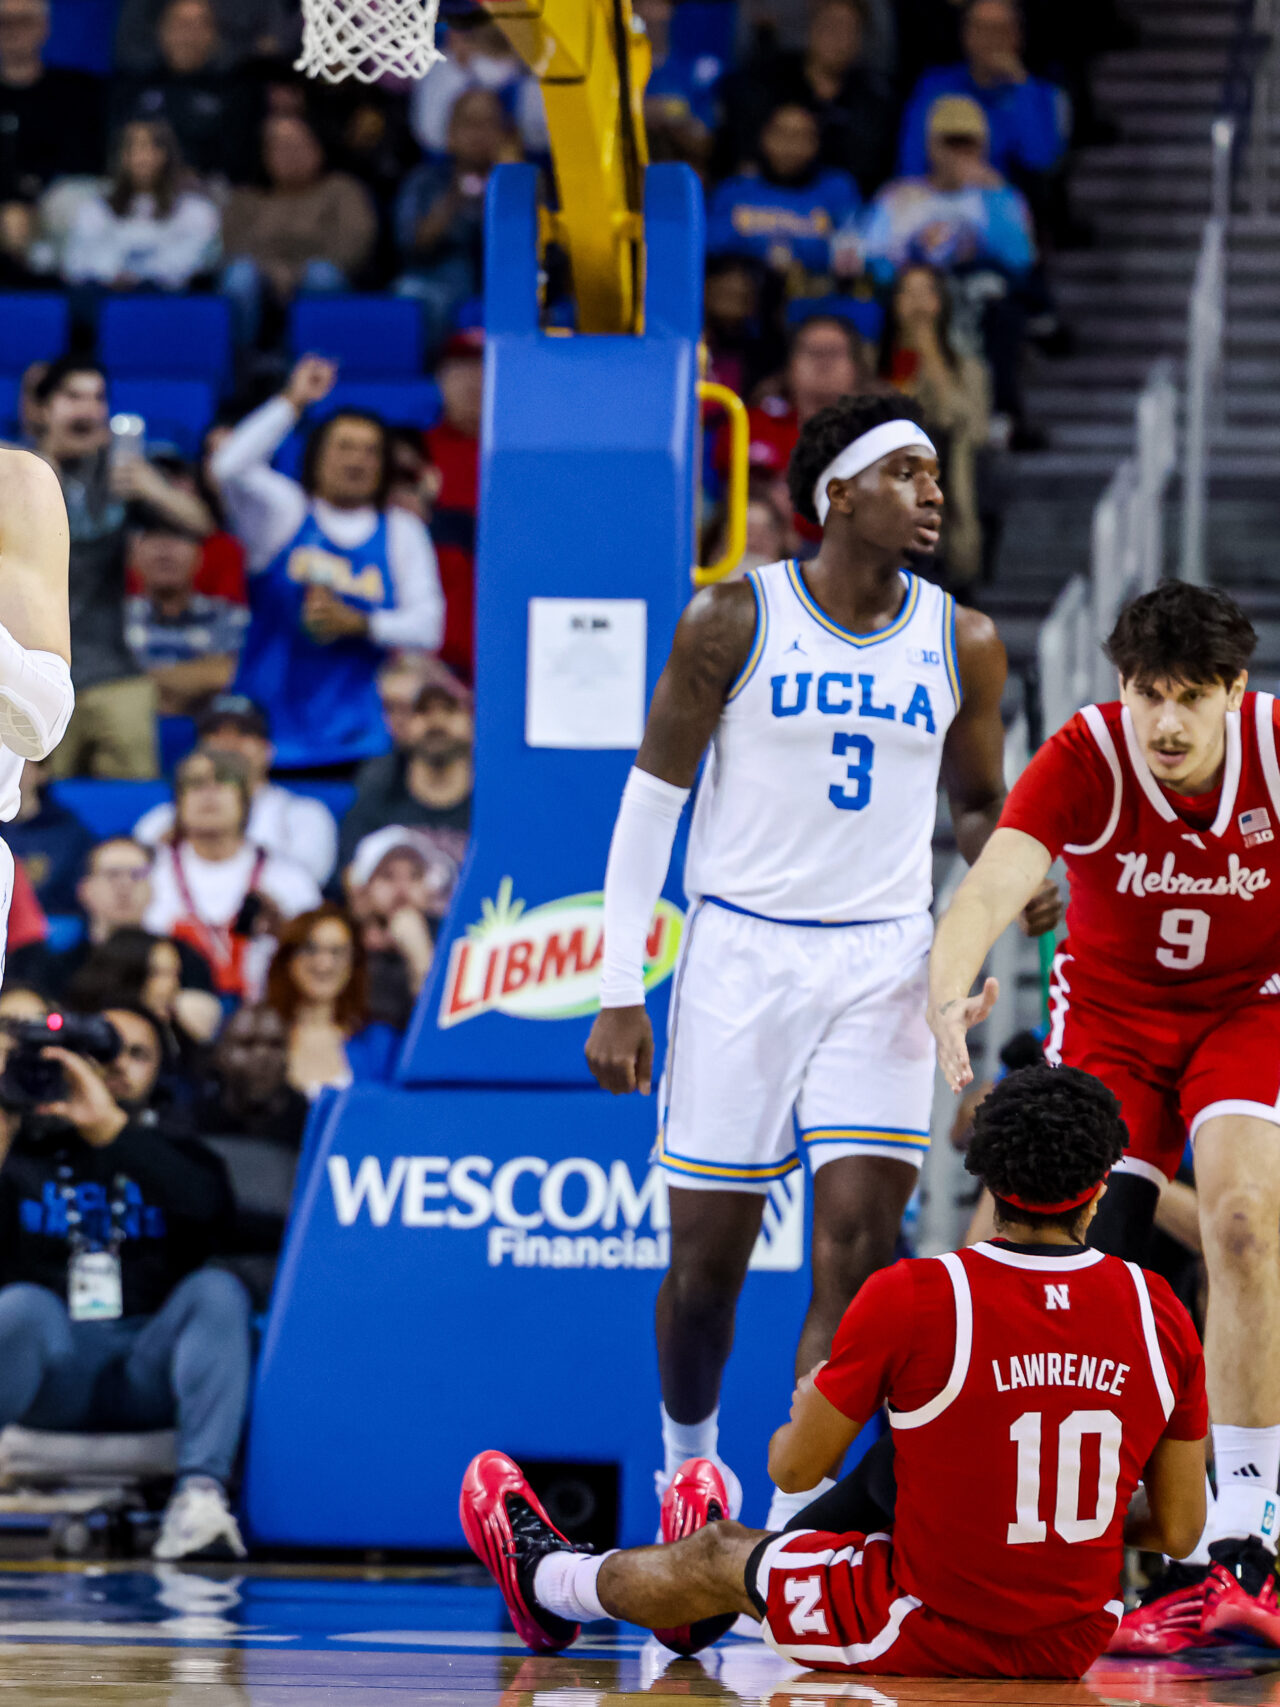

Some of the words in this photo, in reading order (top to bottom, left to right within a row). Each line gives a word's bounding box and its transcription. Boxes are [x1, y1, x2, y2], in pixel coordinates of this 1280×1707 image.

[770, 672, 937, 735] UCLA
[828, 732, 875, 812] 3
[1115, 851, 1271, 901] Nebraska
[1155, 908, 1211, 971] 9
[327, 1155, 670, 1232] WESCOM
[488, 1226, 670, 1269] Financial
[1044, 1284, 1070, 1310] N
[992, 1352, 1131, 1396] LAWRENCE
[1006, 1409, 1122, 1544] 10
[784, 1575, 830, 1636] N
